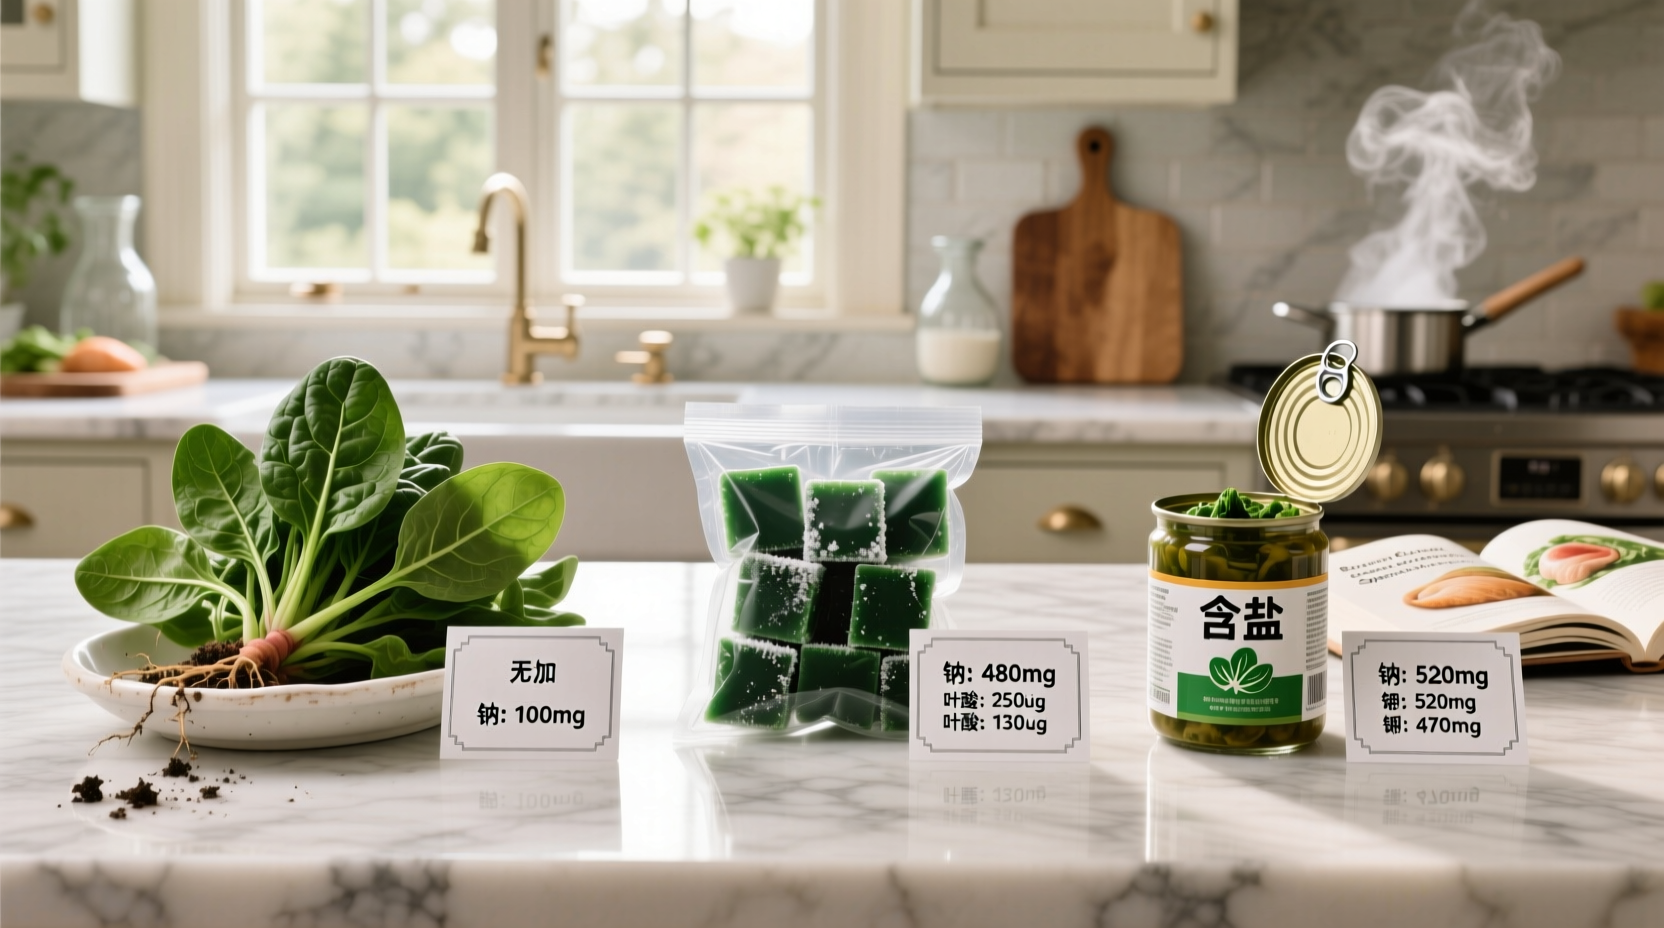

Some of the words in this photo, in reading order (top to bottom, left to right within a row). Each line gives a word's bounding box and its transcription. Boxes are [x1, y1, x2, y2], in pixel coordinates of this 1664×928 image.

[1200, 595, 1284, 641] 含盐
[510, 659, 556, 684] 无加
[981, 663, 1056, 689] 480mg
[1416, 665, 1488, 690] 520mg
[1415, 693, 1476, 714] 520mg
[515, 706, 586, 729] 100mg
[992, 714, 1047, 735] 130ug
[1416, 717, 1481, 738] 470mg
